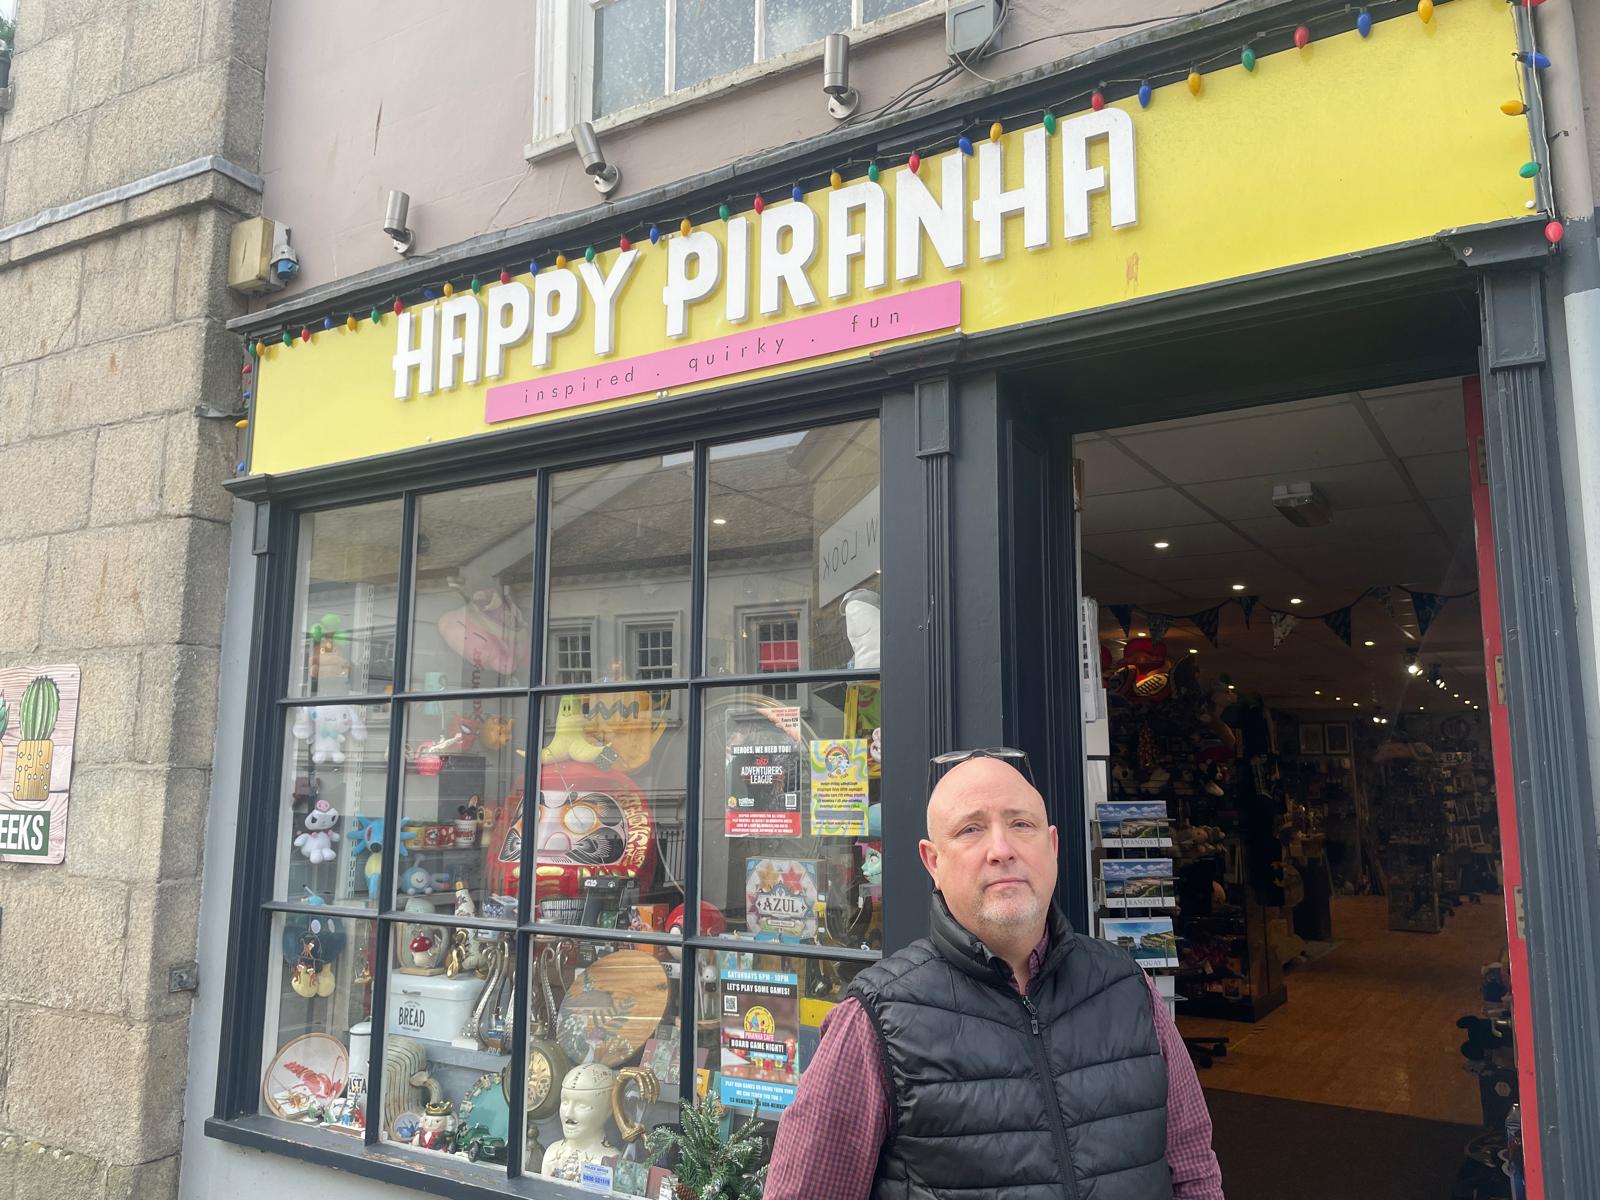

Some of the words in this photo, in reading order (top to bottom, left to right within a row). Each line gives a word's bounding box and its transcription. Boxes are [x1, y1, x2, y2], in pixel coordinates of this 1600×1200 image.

[392, 249, 641, 400] HAPPY
[663, 107, 1137, 337] PIRANHA
[524, 366, 634, 403] inspired
[688, 336, 784, 370] quirky
[851, 311, 900, 333] fun
[755, 746, 764, 754] WE
[765, 746, 777, 754] NEED
[741, 766, 783, 776] ADVENTURERS
[750, 775, 773, 784] LEAGUE
[763, 897, 799, 913] AZUL
[726, 983, 740, 992] LET'S
[741, 984, 753, 993] PLAY
[754, 985, 769, 994] SOME
[770, 986, 790, 996] GAMES!
[398, 1006, 425, 1028] BREAD
[731, 1039, 749, 1049] BOARD
[749, 1040, 765, 1050] GAME
[765, 1042, 784, 1053] NIGHT!
[349, 1078, 367, 1094] ASTA
